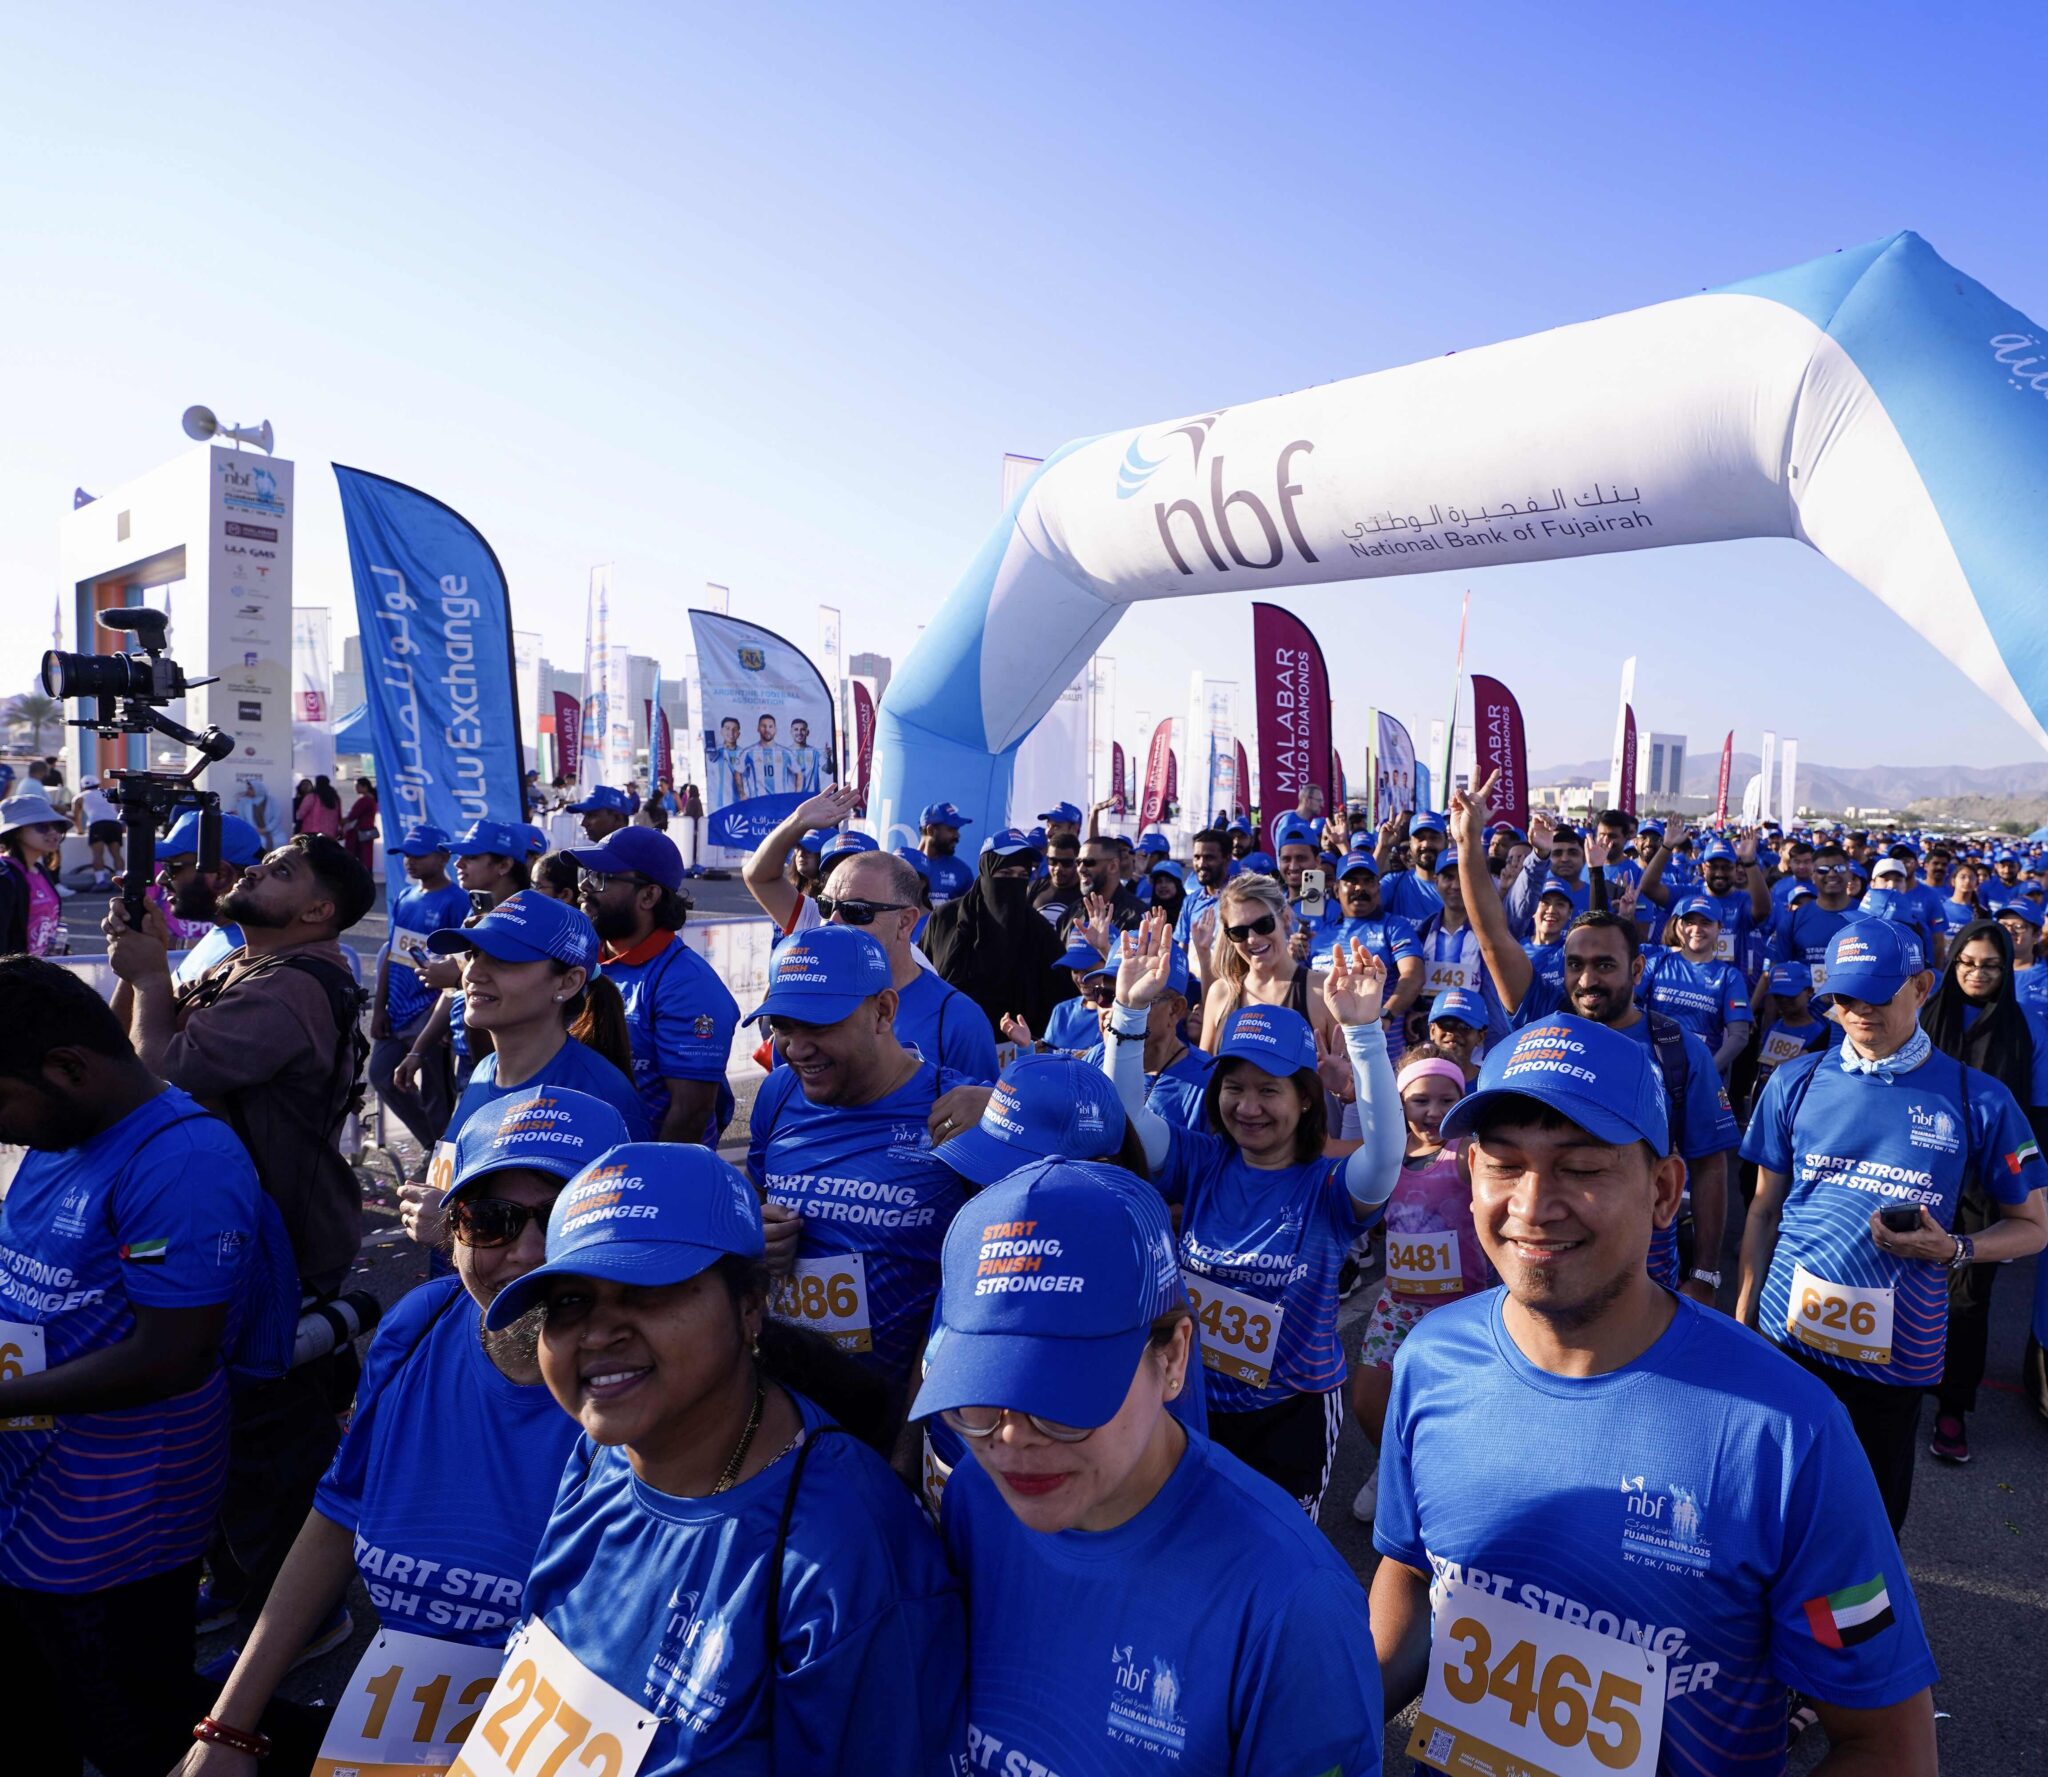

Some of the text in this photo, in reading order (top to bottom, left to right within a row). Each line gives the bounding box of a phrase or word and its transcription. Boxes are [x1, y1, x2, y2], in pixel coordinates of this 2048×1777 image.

[1155, 440, 1320, 575] nbf
[1341, 483, 1641, 543] بنك الفجيرة الوطني
[1348, 510, 1653, 560] National Bank of Fujairah
[370, 564, 418, 658] لولو
[440, 574, 483, 750] Exchange
[1298, 651, 1310, 737] DIAMONDS
[1276, 647, 1297, 794] MALABAR
[562, 707, 577, 767] MALABAR
[1298, 739, 1310, 750] &
[1487, 704, 1505, 810] MAABAR
[1502, 705, 1515, 811] GOLD & DIAMONDS
[763, 764, 775, 777] 10
[1836, 955, 1877, 965] STRONGER
[1838, 943, 1869, 951] STRONG,
[778, 964, 809, 974] FINISH
[781, 955, 820, 966] STRONG,
[777, 973, 828, 984] STRONGER
[1430, 968, 1464, 986] 443
[1237, 1019, 1272, 1031] STRONG,
[1517, 1027, 1573, 1045] START
[1231, 1032, 1278, 1046] STRONGER
[1513, 1037, 1587, 1056] STRONG,
[1507, 1048, 1566, 1067] FINISH
[1501, 1060, 1598, 1085] STRONGER
[501, 1109, 573, 1127] STRONG,
[506, 1098, 558, 1115] START
[1912, 1112, 1935, 1127] nbf
[492, 1131, 584, 1150] STRONGER
[496, 1120, 555, 1137] FINISH
[1804, 1153, 1934, 1190] START STRONG,
[569, 1176, 646, 1206] STRONG,
[814, 1177, 919, 1208] STRONG,
[1848, 1174, 1944, 1207] STRONGER
[559, 1205, 660, 1239] STRONGER
[804, 1199, 936, 1228] STRONGER
[982, 1220, 1038, 1243] START
[979, 1239, 1064, 1261] STRONG,
[1388, 1243, 1451, 1272] 3481
[11, 1255, 80, 1290] STRONG,
[976, 1256, 1042, 1278] FINISH
[2, 1279, 106, 1313] STRONGER
[974, 1275, 1084, 1297] STRONGER
[1801, 1287, 1876, 1336] 626
[1859, 1349, 1882, 1361] 3K
[1238, 1365, 1258, 1382] 3K
[1627, 1491, 1667, 1520] nbf
[1623, 1528, 1711, 1559] FUJAIRAH RUN 2025
[1623, 1552, 1635, 1562] 3K
[1644, 1558, 1657, 1568] 5K
[1665, 1563, 1683, 1574] 10K
[1691, 1569, 1705, 1578] 11K
[1115, 1663, 1151, 1694] nbf
[701, 1688, 727, 1708] 2025
[1443, 1616, 1643, 1770] 3465
[1110, 1701, 1148, 1724] FUJAIRAH
[1147, 1716, 1166, 1729] RUN
[1166, 1722, 1186, 1738] 2025
[1107, 1727, 1117, 1739] 3K
[1143, 1741, 1161, 1753] 10K
[1166, 1748, 1181, 1760] 11K
